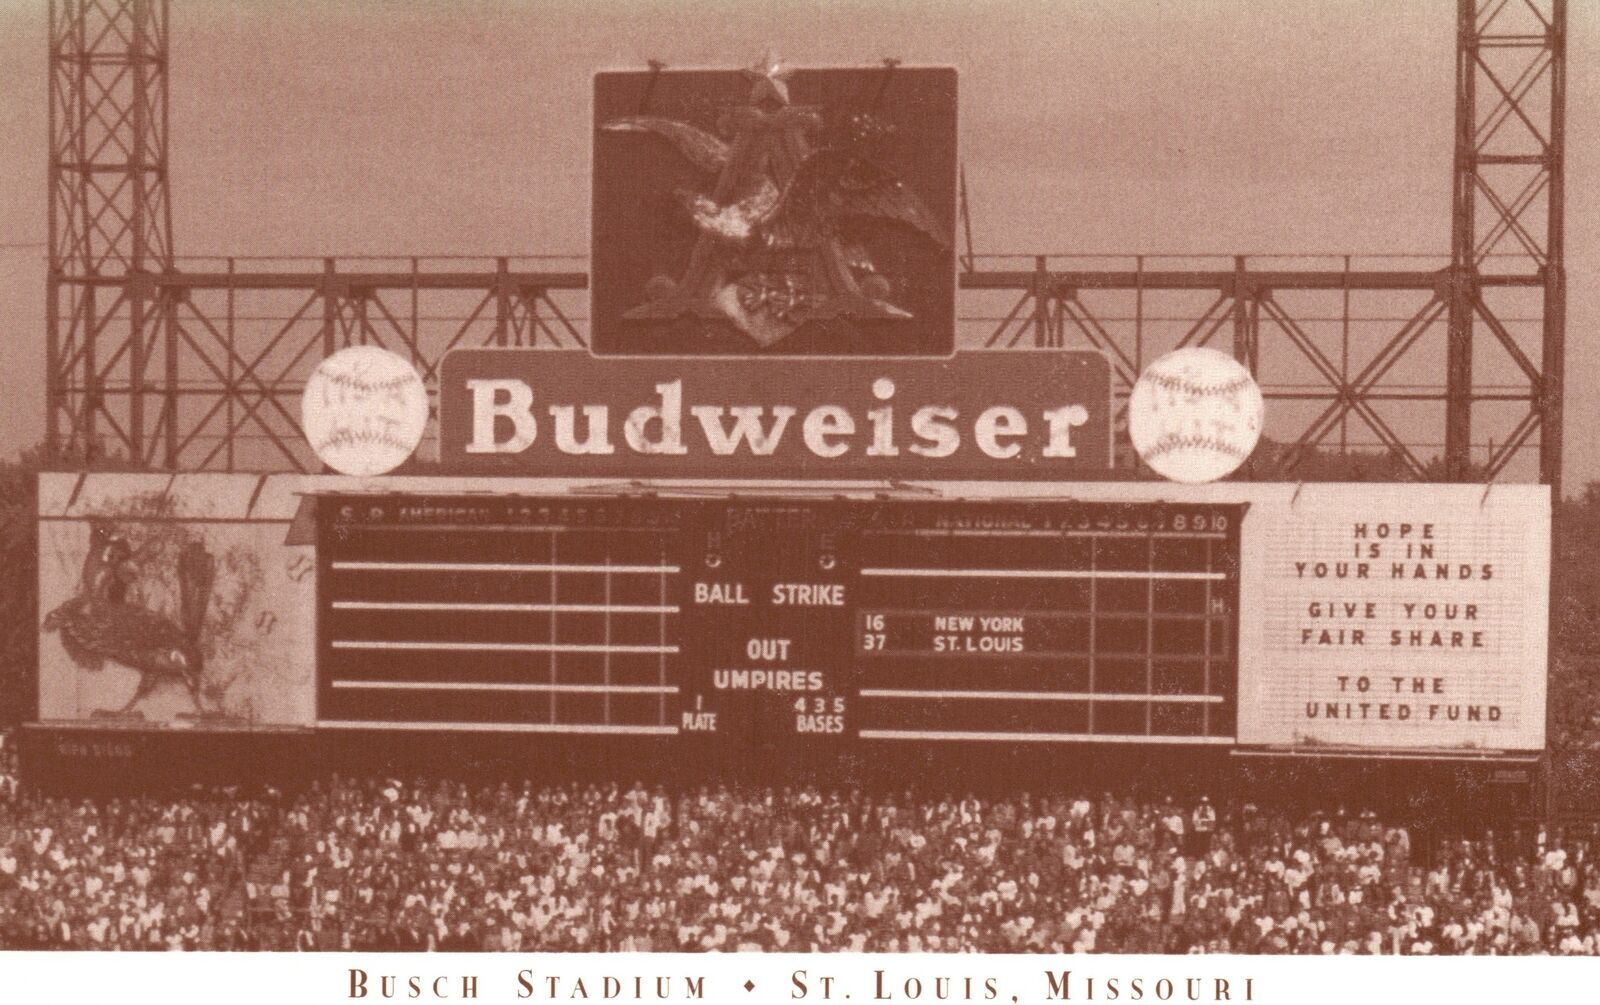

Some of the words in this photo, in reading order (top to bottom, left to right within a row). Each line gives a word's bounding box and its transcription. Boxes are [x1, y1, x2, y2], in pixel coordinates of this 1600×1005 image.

[466, 378, 1088, 458] Budweiser
[1173, 514, 1187, 531] 8
[1355, 523, 1433, 539] HOPE
[1355, 543, 1380, 558] IS
[1408, 544, 1433, 559] IN
[1295, 562, 1369, 578] YOUR
[1392, 563, 1492, 580] HANDS
[695, 583, 749, 603] BALL
[773, 584, 844, 605] STRIKE
[1308, 602, 1376, 619] GIVE
[1404, 603, 1477, 620] YOUR
[867, 615, 884, 630] 16
[936, 617, 973, 631] NEW
[980, 617, 1023, 631] YORK
[864, 634, 885, 650] 37
[934, 636, 960, 651] ST.
[967, 637, 1023, 652] LOUIS
[1302, 629, 1364, 645] FAIR
[1390, 630, 1483, 647] SHARE
[747, 639, 790, 660] OUT
[714, 670, 822, 690] UMPIRES
[1338, 676, 1370, 692] TO
[1392, 677, 1444, 694] THE
[795, 698, 806, 712] 4
[815, 698, 825, 713] 3
[834, 698, 844, 713] 5
[1306, 702, 1411, 720] UNITED
[1429, 705, 1501, 721] FUND
[683, 713, 716, 730] PLATE
[797, 715, 843, 733] BASES
